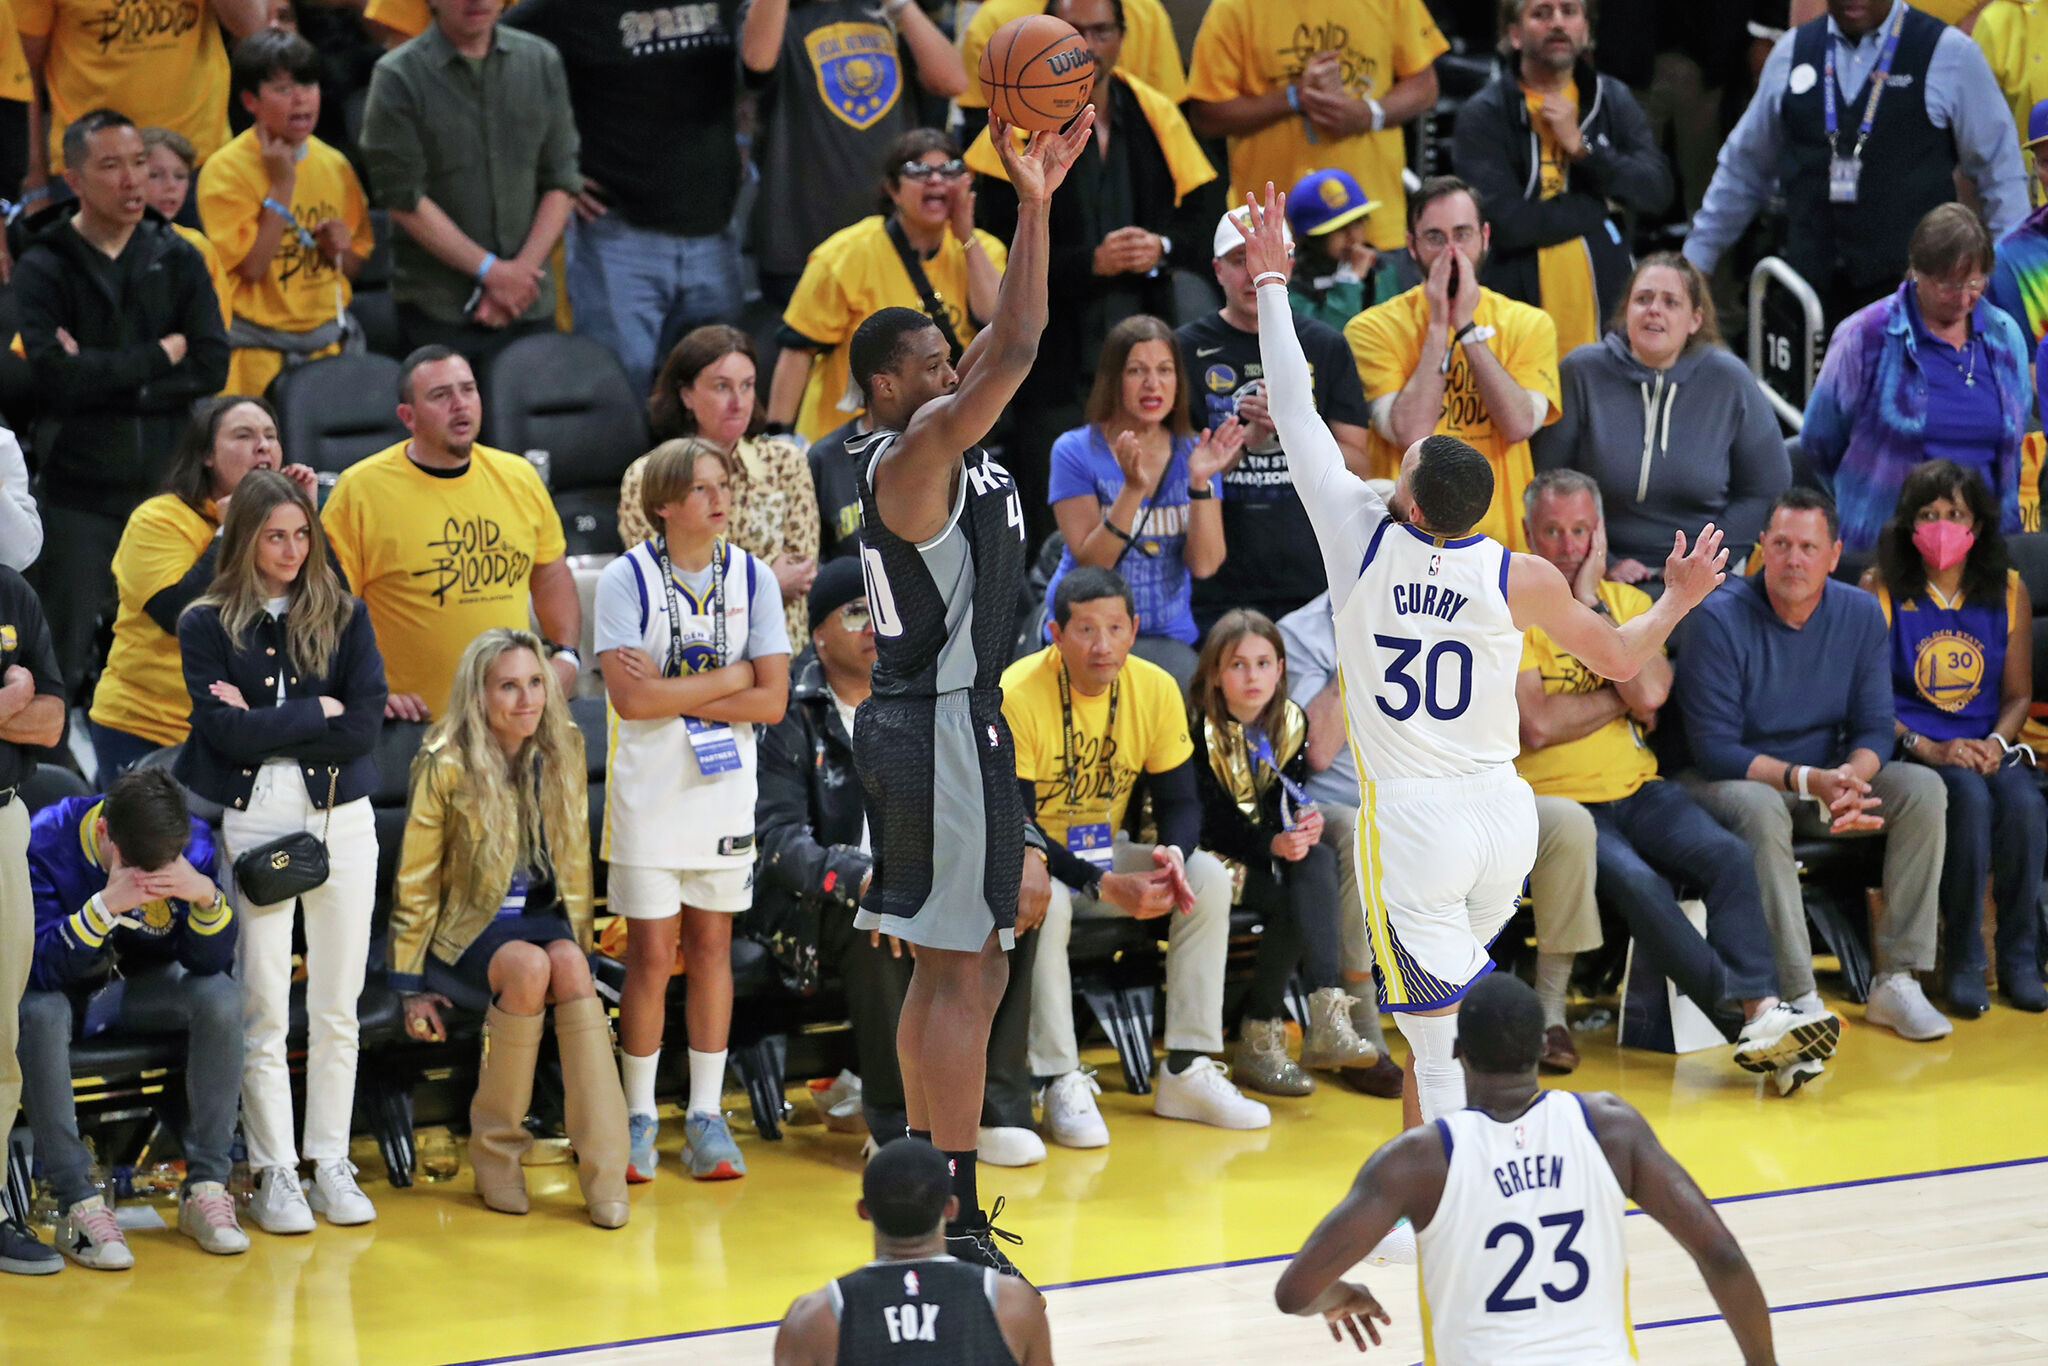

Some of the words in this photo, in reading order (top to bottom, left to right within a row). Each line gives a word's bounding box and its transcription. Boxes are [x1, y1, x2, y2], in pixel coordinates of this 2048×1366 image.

[1046, 46, 1094, 76] Wilso
[1766, 332, 1791, 370] 16
[427, 514, 499, 556] GOLD
[1006, 489, 1025, 541] 4
[412, 551, 530, 608] BLOODED
[660, 554, 673, 582] CHASE
[667, 596, 680, 628] CENTER
[859, 538, 905, 638] 0
[1393, 582, 1469, 623] CURRY
[683, 630, 706, 642] DEN
[1914, 629, 1953, 653] GOLDEN
[1956, 629, 1985, 651] STATE
[1373, 633, 1473, 722] 30
[1947, 651, 1973, 670] 30
[1494, 1154, 1564, 1198] GREEN
[1484, 1209, 1590, 1312] 23
[883, 1302, 940, 1344] FOX
